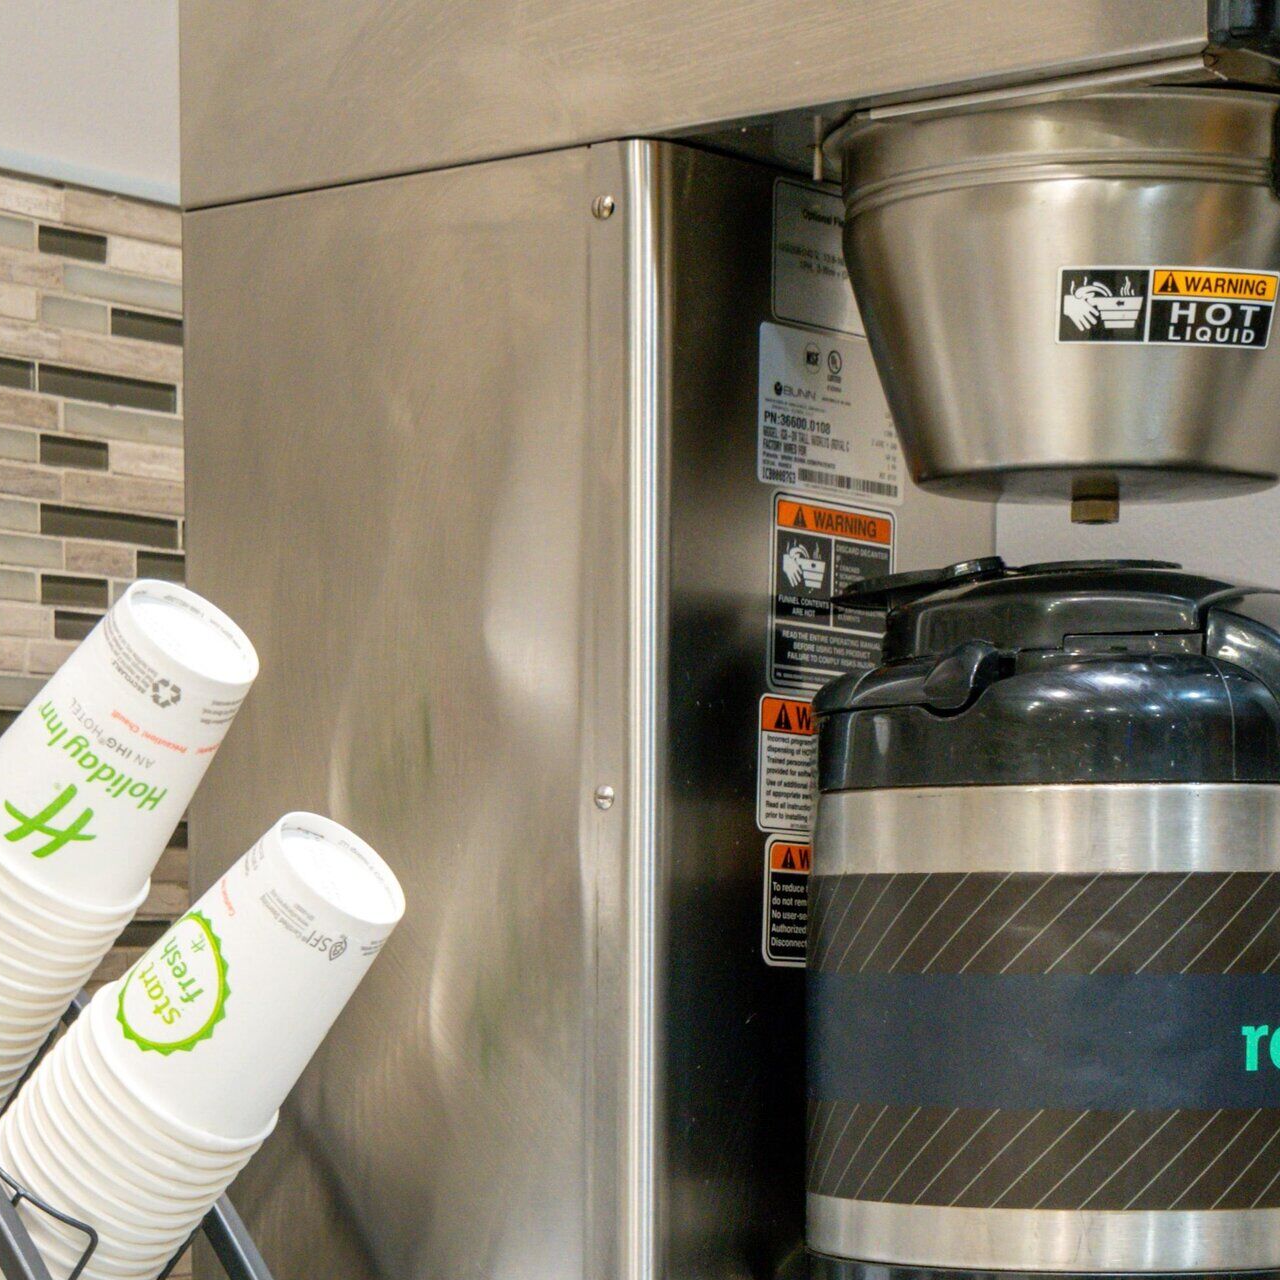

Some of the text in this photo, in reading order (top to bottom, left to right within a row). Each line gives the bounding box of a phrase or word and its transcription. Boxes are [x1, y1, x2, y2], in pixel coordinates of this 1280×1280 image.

[1185, 276, 1267, 296] WARNING
[1170, 302, 1261, 327] HOT
[1168, 325, 1255, 344] LIQUID
[783, 385, 816, 399] BUNN
[813, 509, 877, 538] WARNING
[778, 594, 800, 605] FUNNEL
[801, 598, 829, 610] CONTENTS
[792, 607, 815, 617] ARE HOT
[782, 630, 798, 639] READ
[810, 633, 828, 643] ENTIRE
[793, 641, 816, 652] BEFORE
[846, 648, 871, 659] PRODUCT
[787, 651, 810, 661] FAILURE
[819, 656, 839, 665] COMPLY
[70, 697, 103, 738] HOTEL
[767, 734, 789, 744] Incorrect
[39, 700, 167, 811] Holiday Inn
[767, 745, 795, 756] dispensing
[135, 754, 155, 769] AN
[767, 756, 785, 765] Trained
[767, 767, 789, 777] provided
[766, 778, 776, 786] Use
[784, 781, 808, 789] additional
[772, 790, 800, 799] appropriate
[766, 800, 778, 809] Read
[765, 811, 777, 820] prior
[785, 813, 808, 823] installing
[782, 883, 804, 894] reduce
[782, 897, 793, 906] not
[771, 923, 806, 934] Authorized
[160, 936, 205, 1004] fresh
[138, 961, 182, 1025] start
